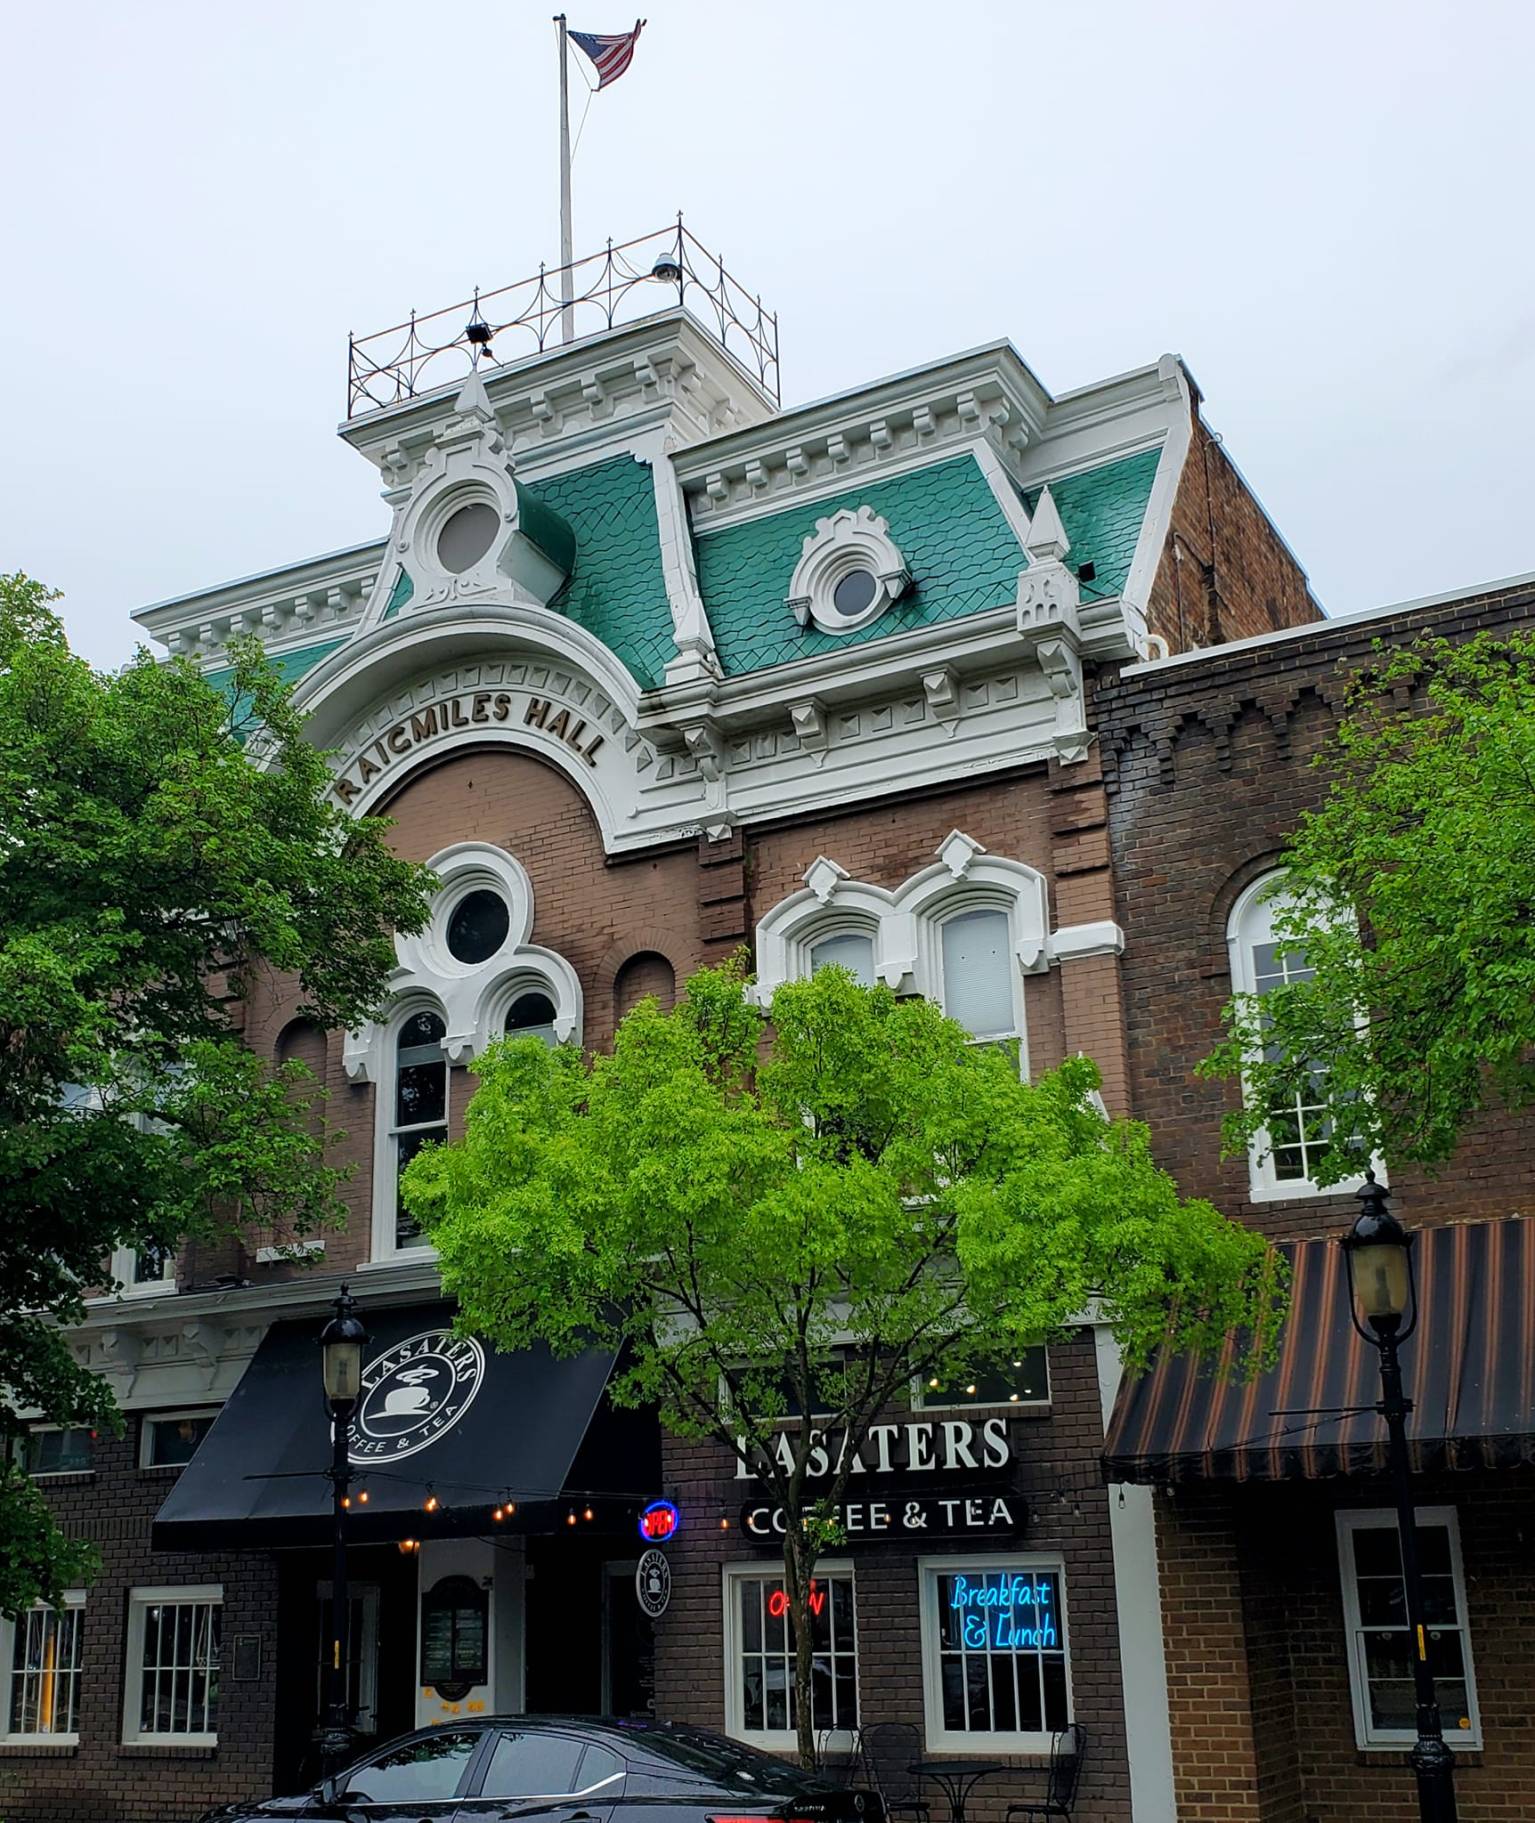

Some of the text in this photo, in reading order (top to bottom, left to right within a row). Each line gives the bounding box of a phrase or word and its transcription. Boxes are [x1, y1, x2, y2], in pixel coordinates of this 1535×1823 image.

[333, 693, 605, 806] RAIGMILES HALL
[361, 1336, 476, 1389] LASATERS
[347, 1405, 458, 1453] OFFEE & TEA
[733, 1418, 1009, 1479] LASATERS
[903, 1501, 927, 1528] &
[938, 1498, 1014, 1526] TEA
[769, 1588, 826, 1616] ON
[950, 1573, 1051, 1610] Breakfast
[964, 1611, 1055, 1648] & Lunch
